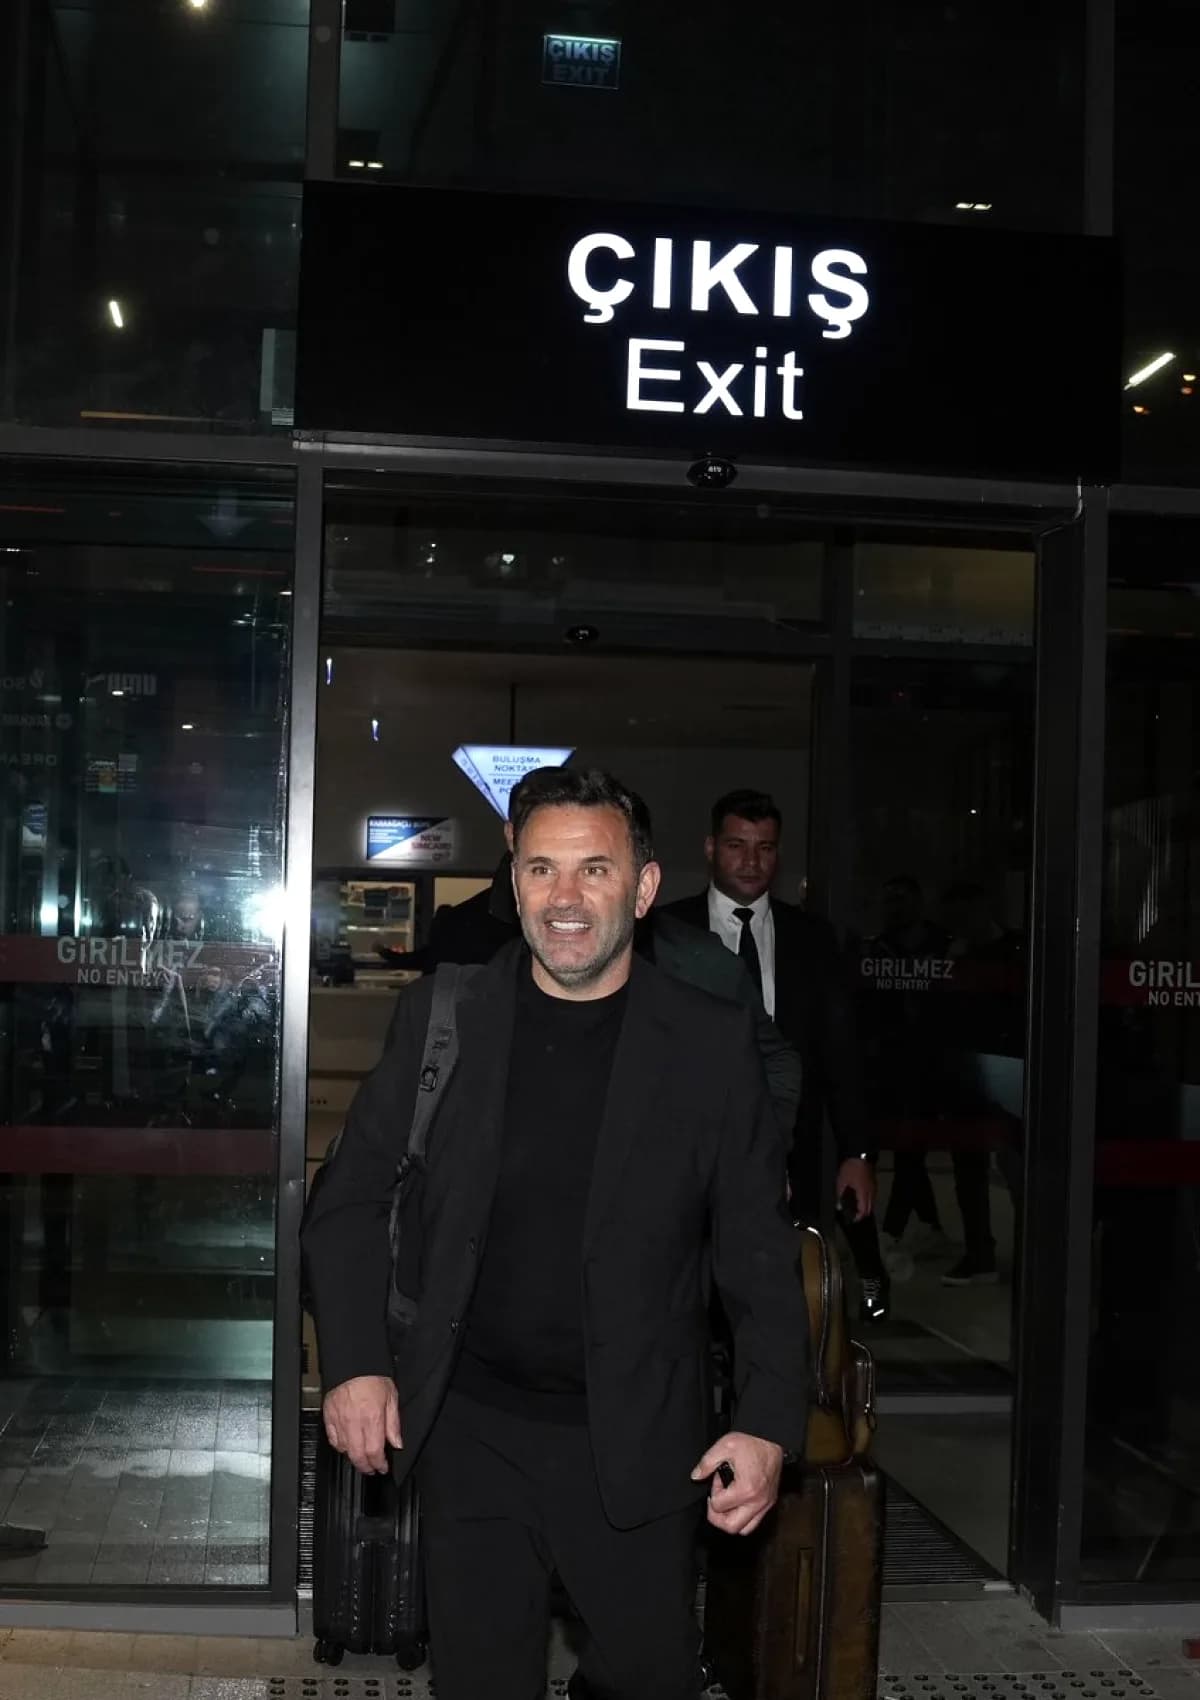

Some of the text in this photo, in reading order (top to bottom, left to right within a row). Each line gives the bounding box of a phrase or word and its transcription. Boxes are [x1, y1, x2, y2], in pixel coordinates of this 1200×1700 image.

[548, 40, 616, 65] ÇIKIŞ
[552, 62, 609, 82] EXIT
[567, 232, 870, 340] ÇIKIŞ
[626, 338, 804, 420] Exit
[492, 755, 541, 764] BULUŞMA
[77, 968, 101, 984] NO
[876, 978, 930, 991] NO ENTRY
[1148, 989, 1170, 1006] NO
